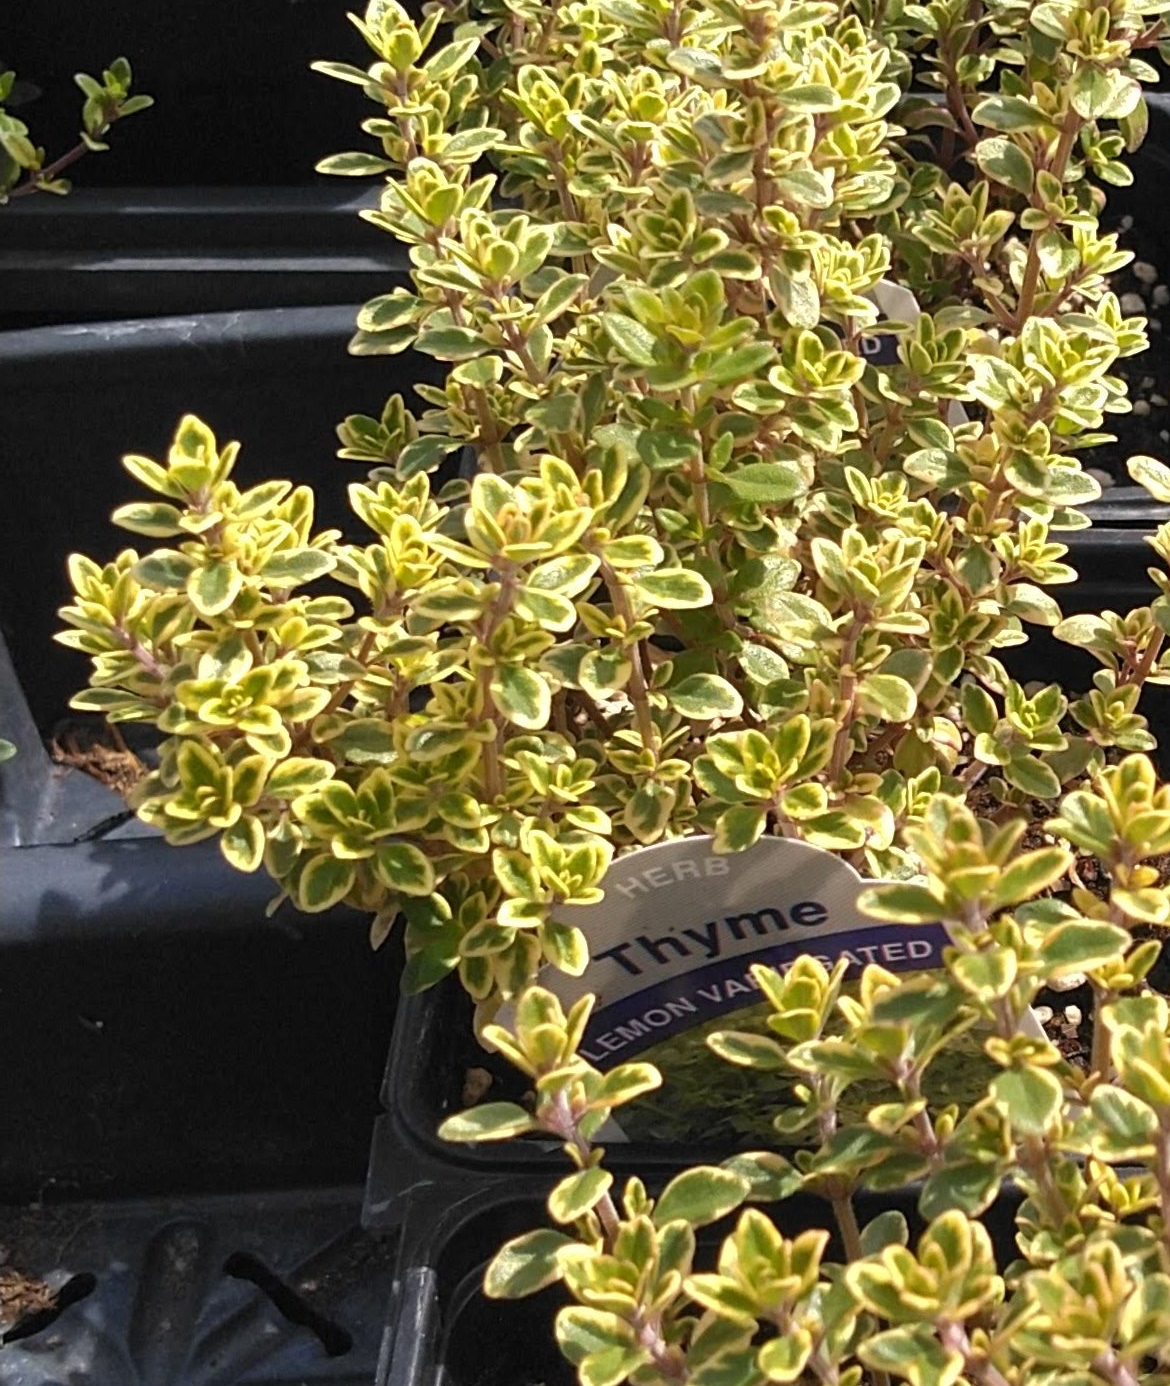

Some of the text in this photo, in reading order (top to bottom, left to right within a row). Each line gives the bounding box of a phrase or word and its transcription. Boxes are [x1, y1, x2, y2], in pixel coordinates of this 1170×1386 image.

[614, 855, 732, 900] HERB
[592, 900, 829, 977] Thyme
[579, 994, 698, 1063] LEMON
